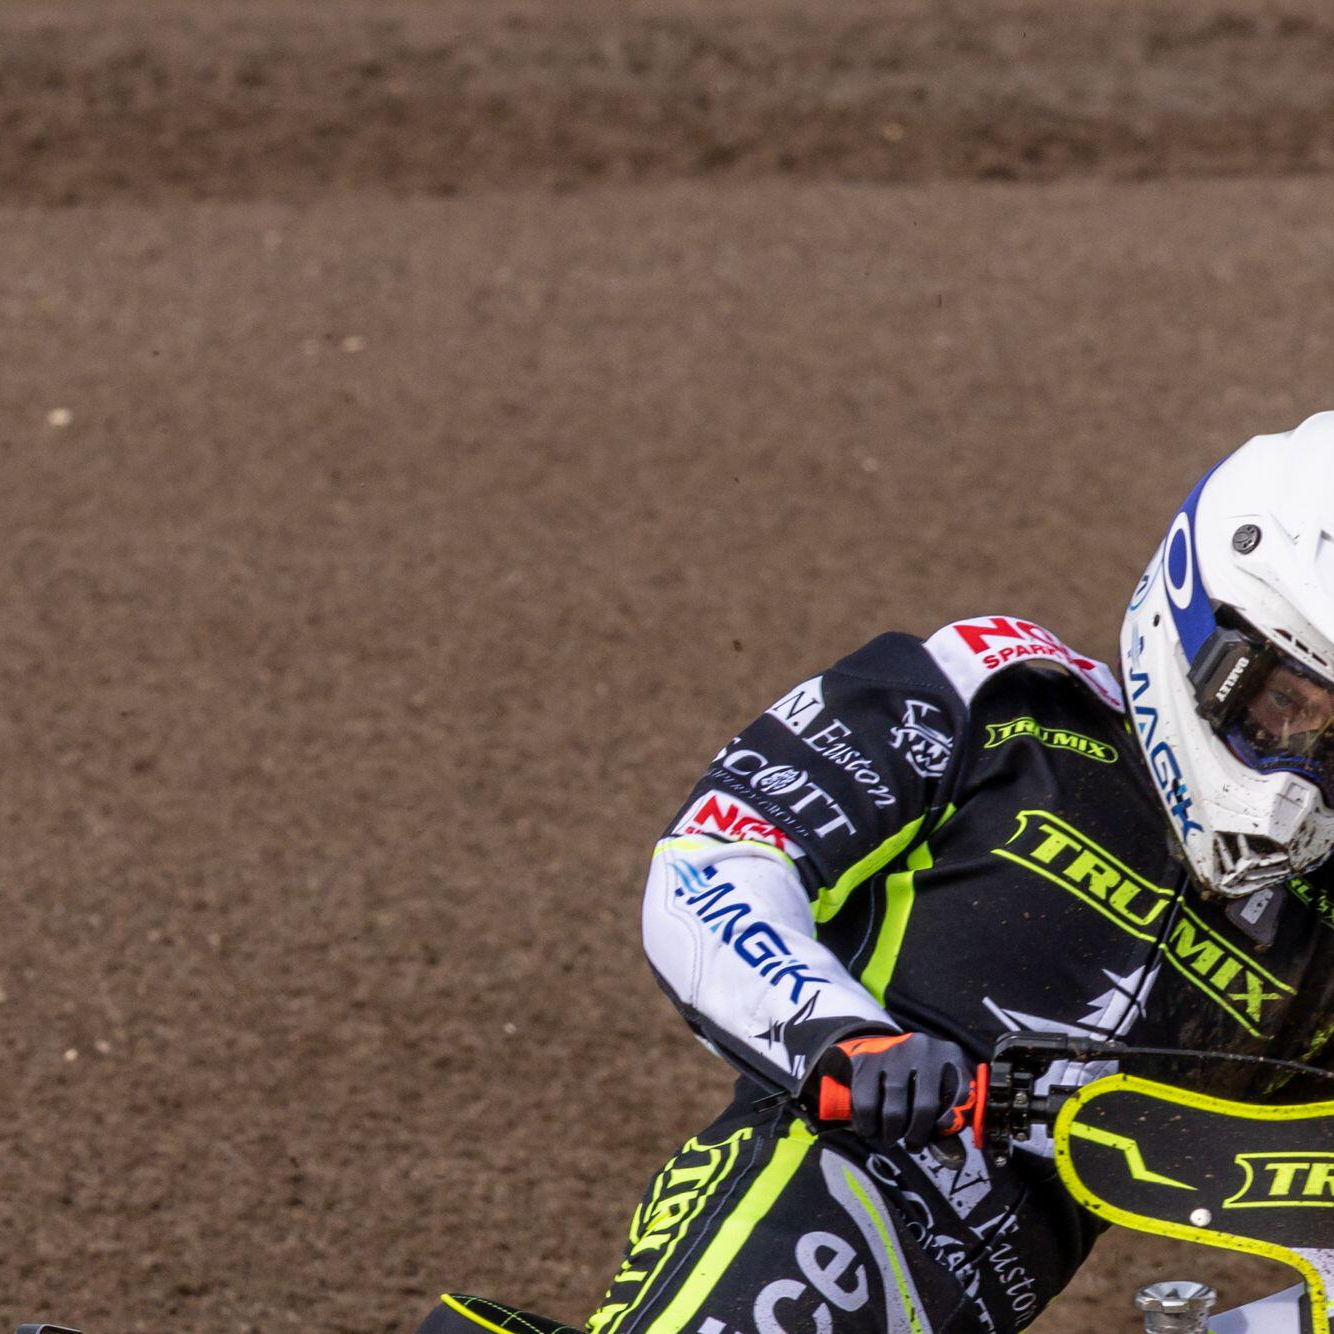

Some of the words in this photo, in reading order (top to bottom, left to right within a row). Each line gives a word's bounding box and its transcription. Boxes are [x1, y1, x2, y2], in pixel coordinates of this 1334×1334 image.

[1216, 656, 1250, 702] OAKLEY
[802, 718, 896, 807] Euston
[1053, 732, 1106, 758] MIX
[1029, 823, 1171, 926] TRU
[1169, 917, 1283, 1022] MIX
